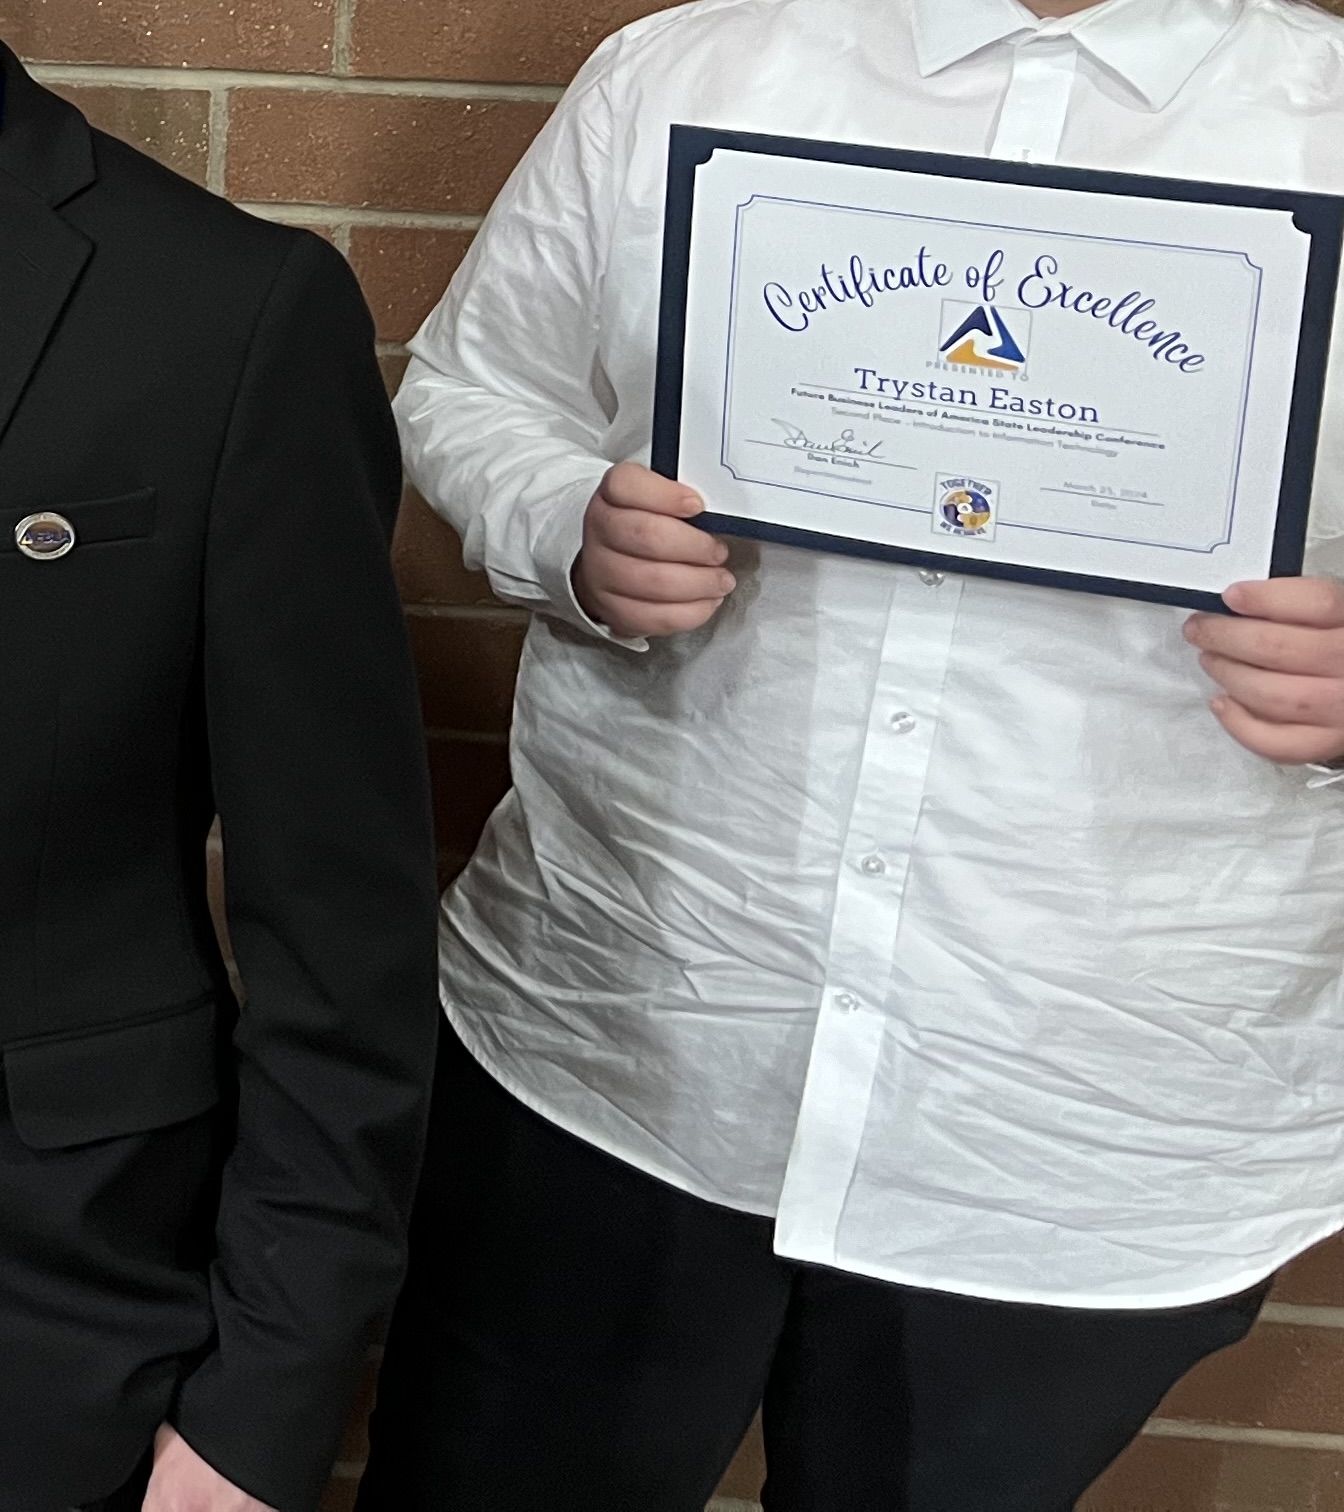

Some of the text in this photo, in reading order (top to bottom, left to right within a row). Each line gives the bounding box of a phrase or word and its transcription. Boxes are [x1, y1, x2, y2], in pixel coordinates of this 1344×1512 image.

[764, 247, 1207, 374] Certificate of Excellence
[854, 368, 1099, 423] Trystan Easton
[926, 361, 1029, 382] PRESENTED TO
[791, 388, 1166, 449] Future Business Leaders of America State Leadership Conference
